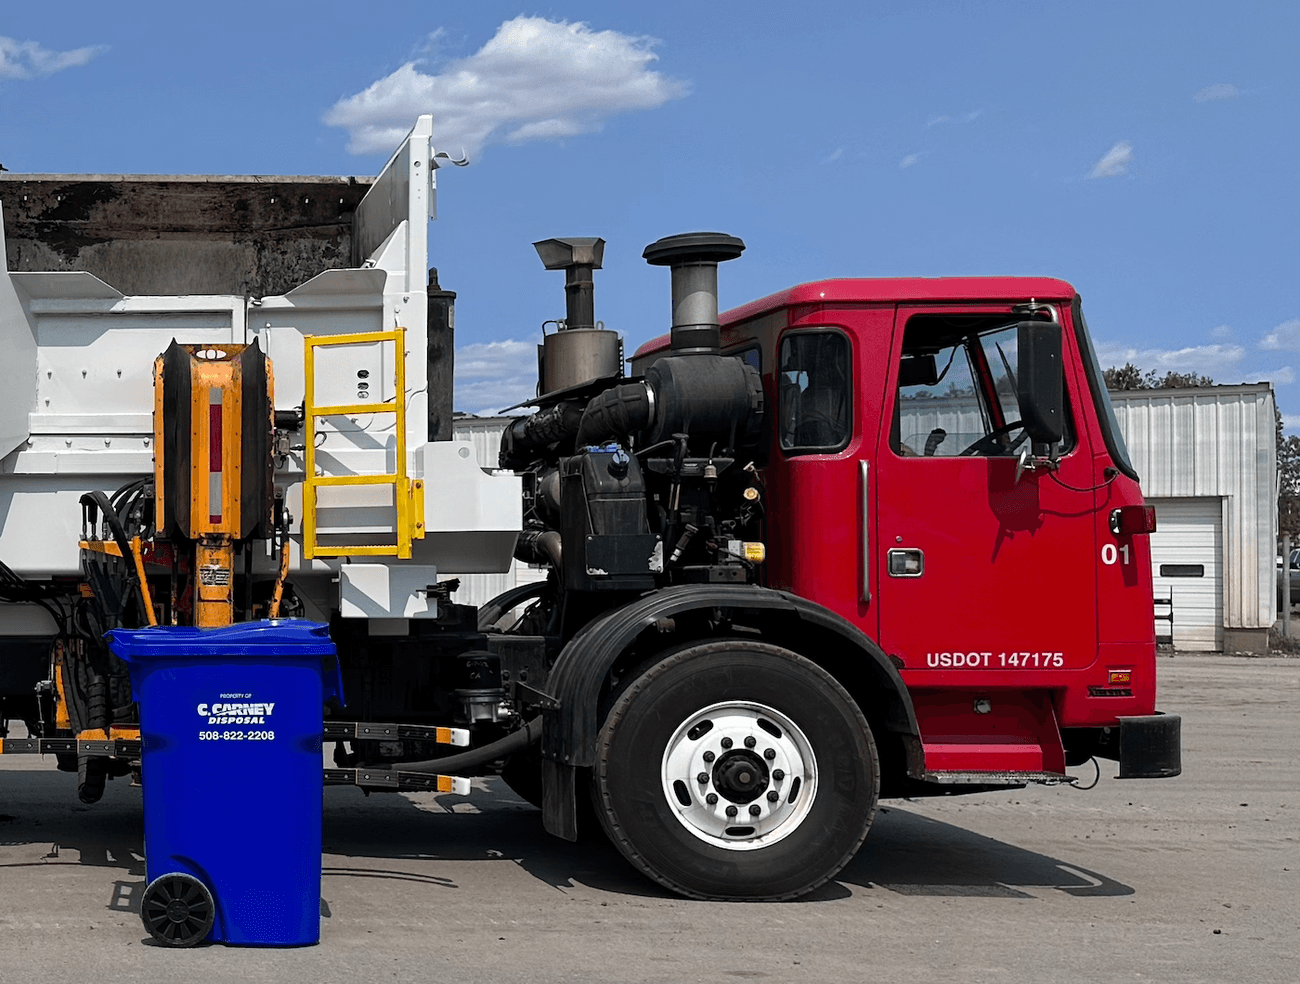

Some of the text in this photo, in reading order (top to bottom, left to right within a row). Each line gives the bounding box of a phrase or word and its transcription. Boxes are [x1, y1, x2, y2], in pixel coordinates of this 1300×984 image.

[1101, 543, 1130, 565] 01
[926, 652, 1064, 667] USDOT 147175
[197, 702, 275, 716] C. CARNEY
[207, 717, 265, 725] DISPOSAL
[198, 731, 275, 740] 508-822-2208
